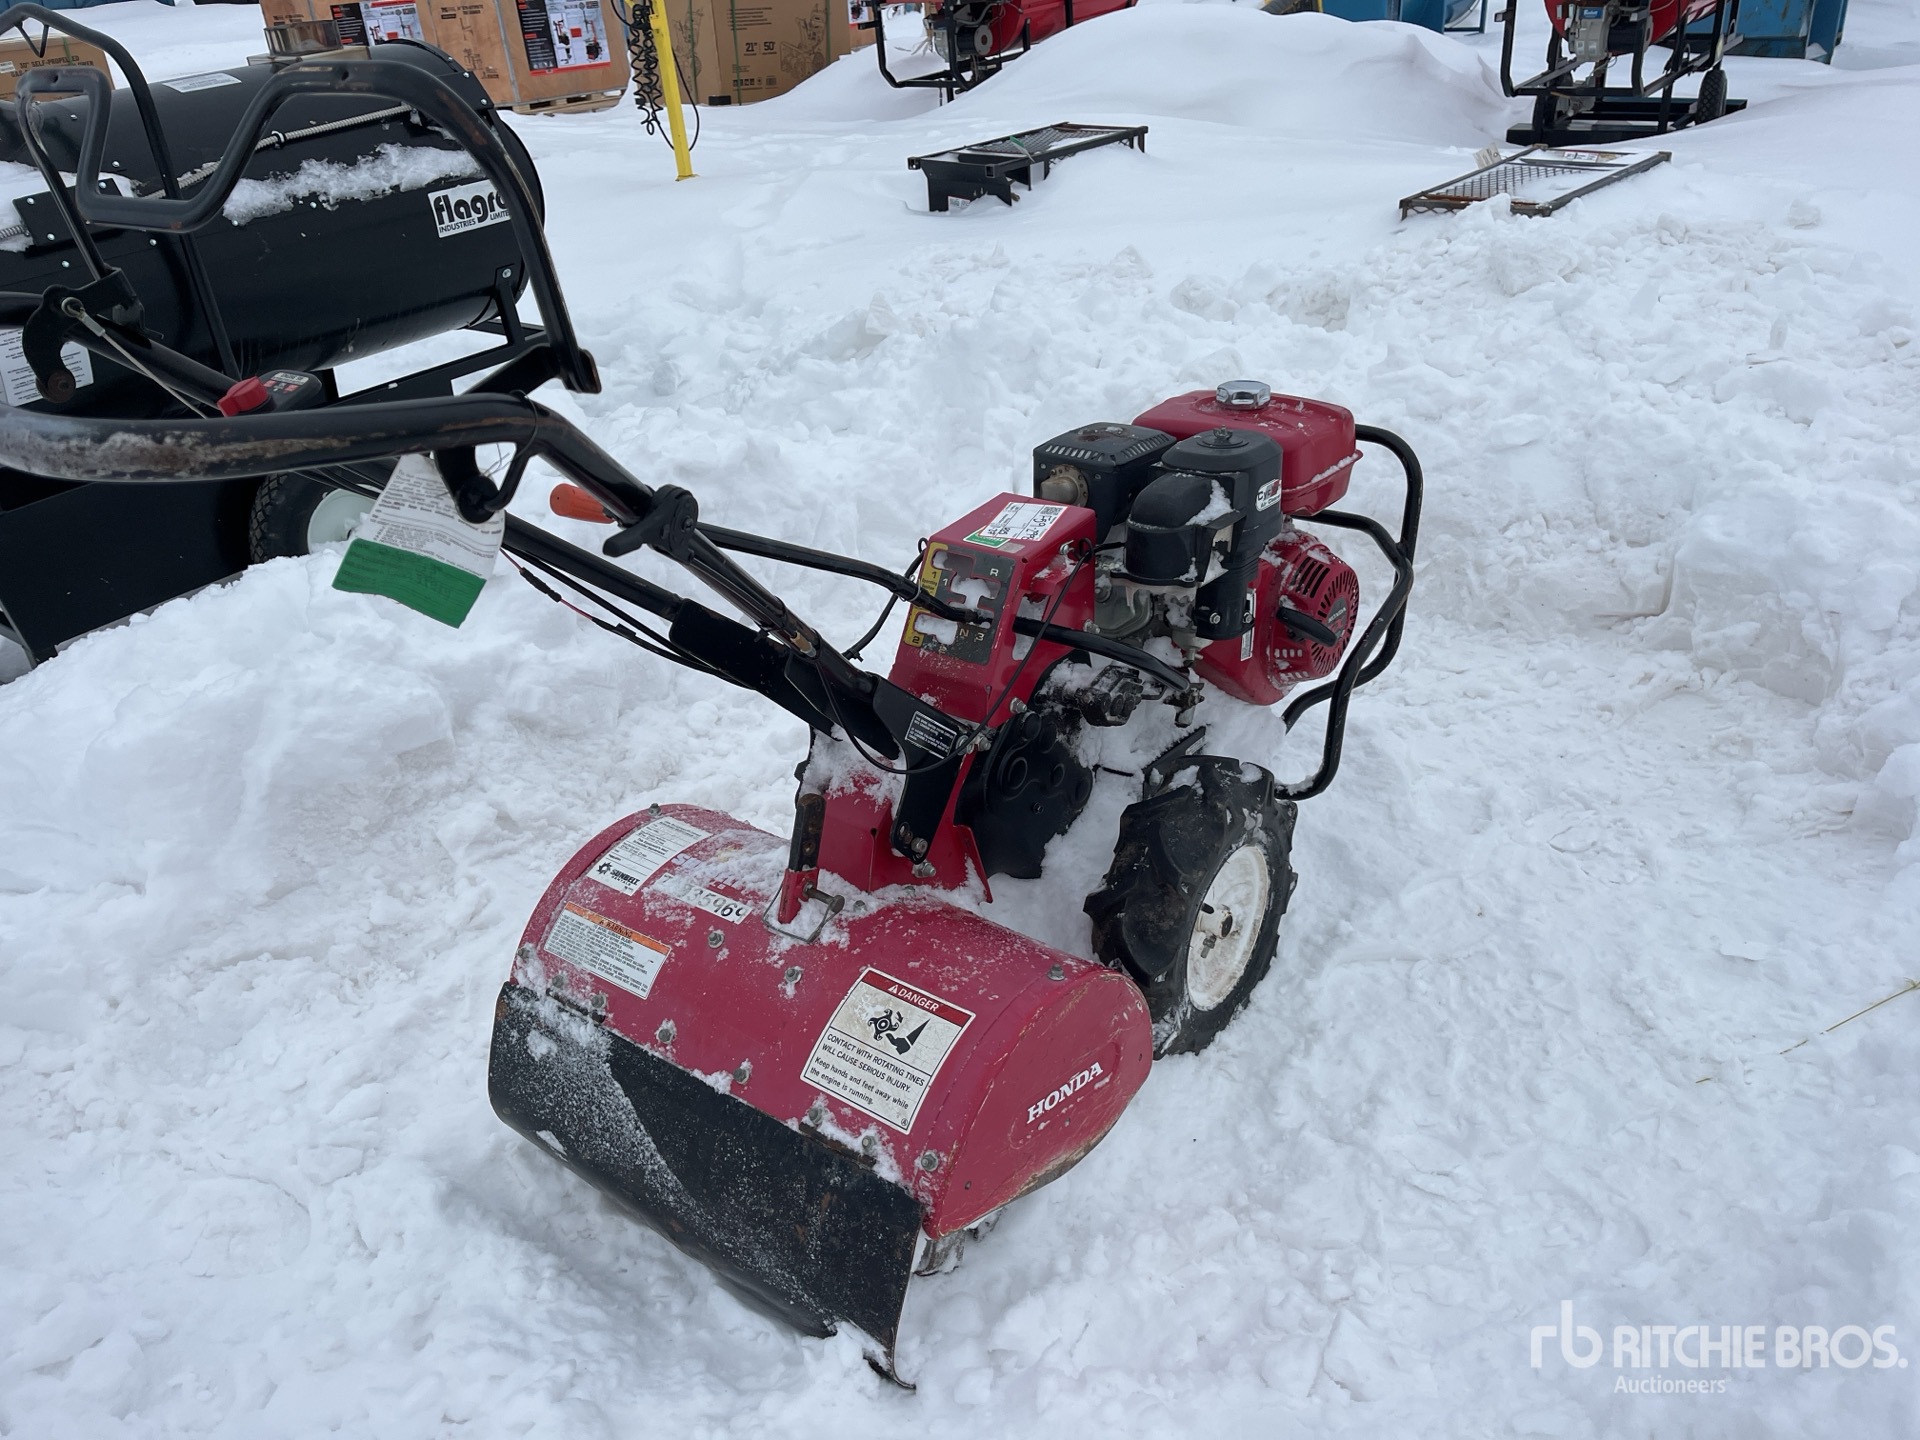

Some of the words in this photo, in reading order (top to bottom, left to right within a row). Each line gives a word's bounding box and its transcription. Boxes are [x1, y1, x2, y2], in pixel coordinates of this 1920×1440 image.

[31, 55, 80, 68] SELF-PROPELED
[439, 218, 476, 233] INDUSTRIES
[989, 568, 999, 577] R
[912, 636, 920, 644] 2
[959, 628, 969, 637] N
[975, 632, 985, 641] 3
[610, 868, 641, 886] SUNBELT
[897, 987, 940, 1012] DANGER
[822, 1043, 836, 1056] WILL
[837, 1051, 859, 1067] CAUSE
[858, 1061, 886, 1080] SERIOUS
[886, 1076, 911, 1093] INJURY.
[827, 1033, 856, 1052] CONTACT
[856, 1047, 873, 1061] WITH
[873, 1055, 904, 1077] ROTATING
[905, 1071, 926, 1087] TINES
[810, 1067, 820, 1077] the
[820, 1074, 841, 1088] engine
[841, 1082, 848, 1091] is
[848, 1086, 874, 1105] running.
[814, 1056, 831, 1070] Keep
[830, 1065, 848, 1079] hands
[849, 1075, 861, 1086] and
[862, 1081, 875, 1092] feet
[875, 1087, 891, 1102] away
[892, 1096, 909, 1110] while
[1026, 1061, 1103, 1125] HONDA
